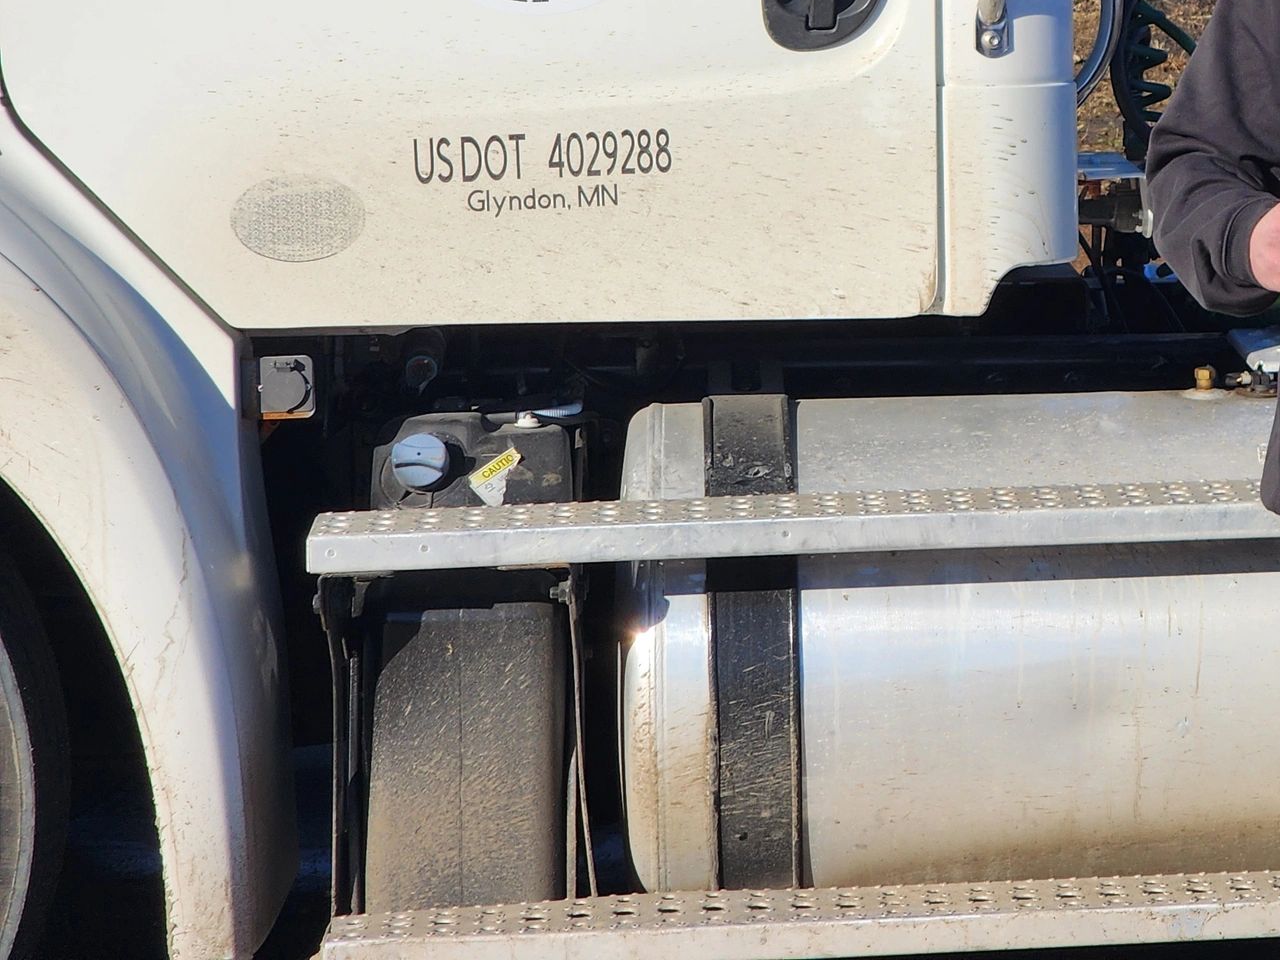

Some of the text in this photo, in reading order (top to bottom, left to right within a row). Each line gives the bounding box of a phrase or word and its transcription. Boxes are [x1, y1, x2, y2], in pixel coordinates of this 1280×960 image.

[548, 128, 672, 178] 4029288
[467, 183, 618, 218] Glyndon, MN
[481, 454, 514, 479] CAUTIO
